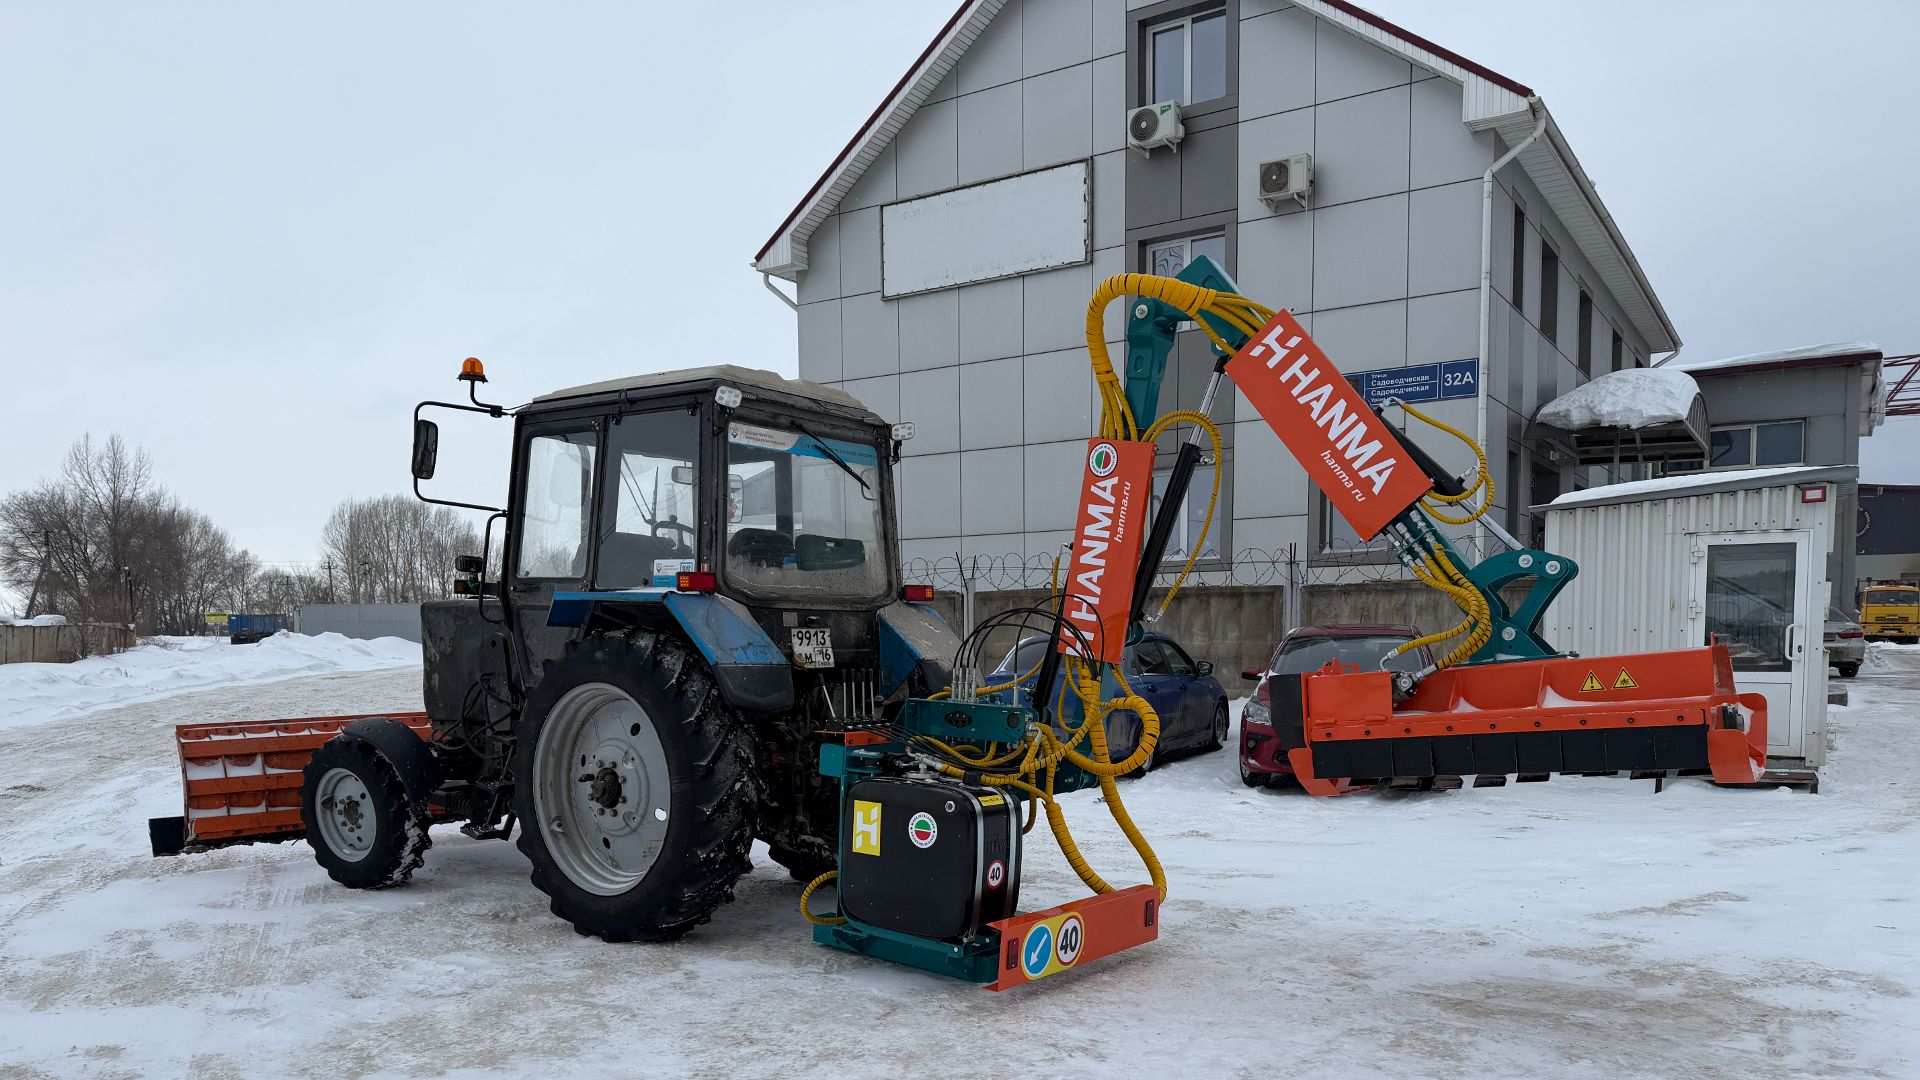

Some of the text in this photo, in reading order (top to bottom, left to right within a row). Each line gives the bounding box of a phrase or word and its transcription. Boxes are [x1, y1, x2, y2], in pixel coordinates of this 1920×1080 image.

[1371, 375, 1430, 387] Садоводческая
[1371, 385, 1430, 396] Садоводческая
[1279, 353, 1397, 496] HANMA
[1320, 449, 1367, 503] hanma.ru
[1113, 481, 1132, 544] hanma.ru
[1071, 476, 1118, 621] HANMA
[796, 630, 826, 647] 9913
[989, 866, 1001, 881] 40
[1060, 925, 1079, 954] 40
